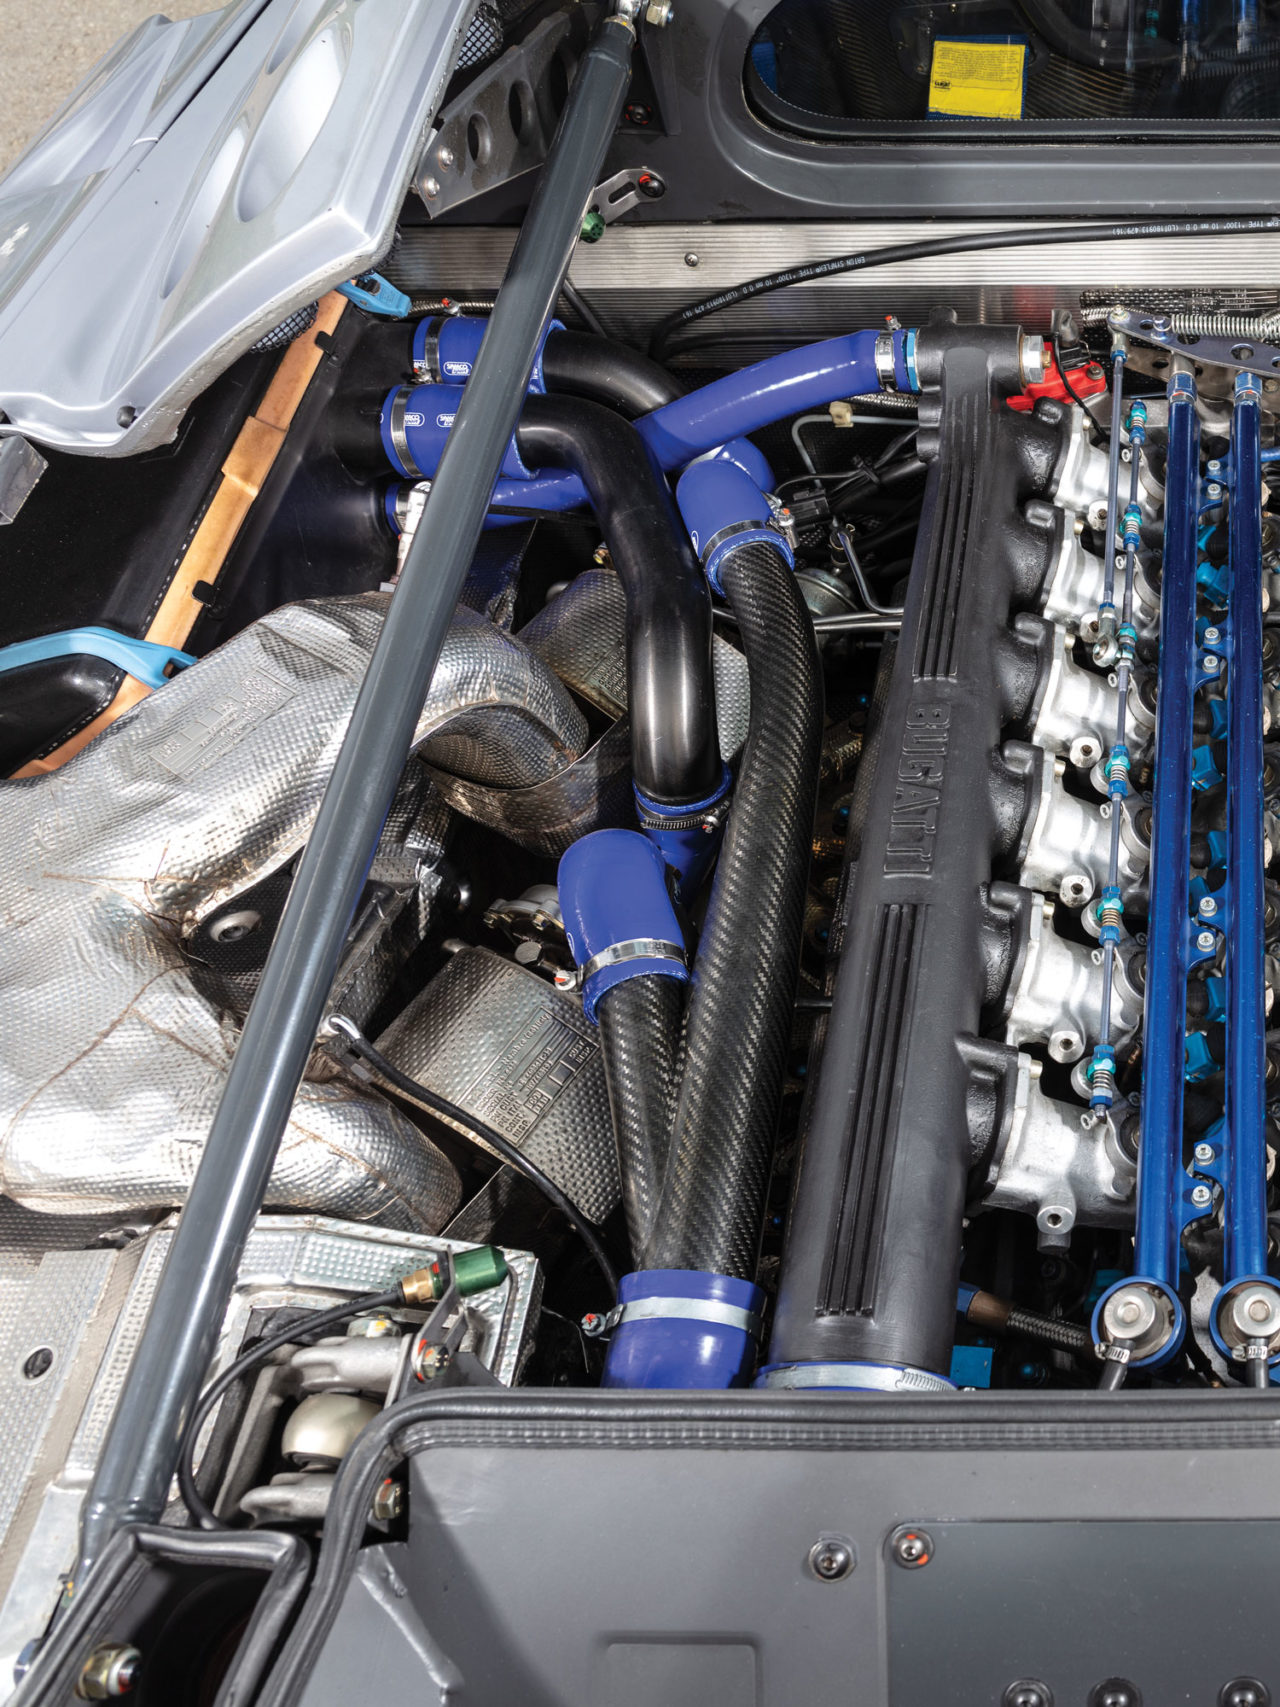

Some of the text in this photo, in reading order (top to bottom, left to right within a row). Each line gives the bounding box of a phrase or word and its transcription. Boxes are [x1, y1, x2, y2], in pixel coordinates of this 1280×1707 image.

[1248, 220, 1264, 228] TYPE
[847, 256, 865, 267] EATON
[799, 269, 813, 277] TYPE
[884, 702, 951, 878] BUGATTI
